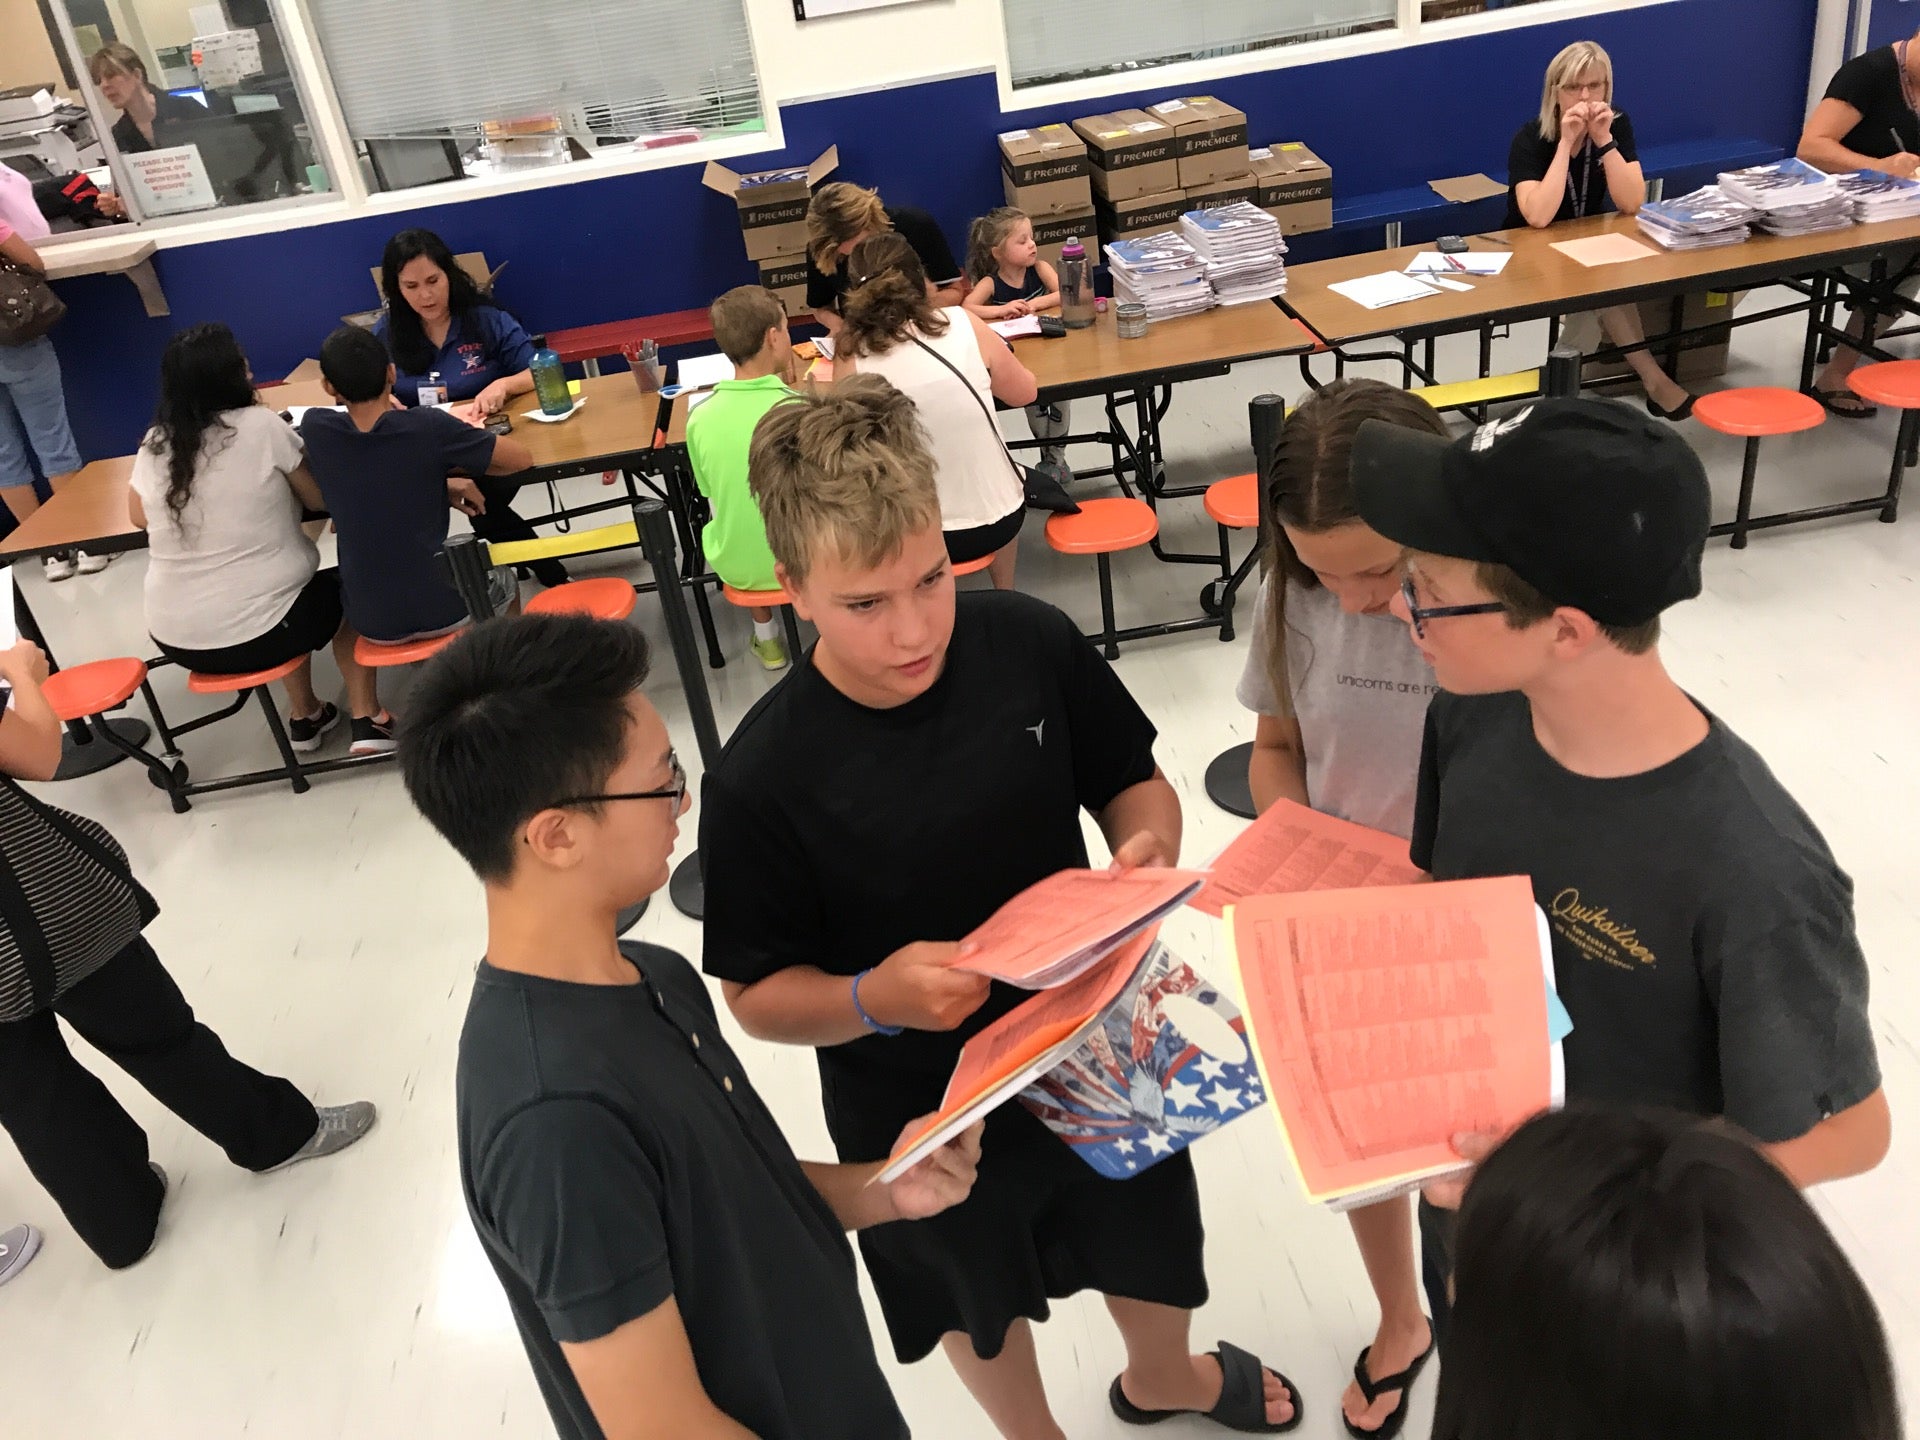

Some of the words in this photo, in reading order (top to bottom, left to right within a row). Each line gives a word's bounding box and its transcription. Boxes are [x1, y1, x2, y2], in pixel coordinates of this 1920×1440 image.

[1194, 133, 1239, 149] PREMIER
[1122, 147, 1166, 162] PREMIER
[1033, 164, 1079, 179] PREMIER
[1278, 187, 1322, 200] PREMIER
[758, 207, 802, 221] PREMIER
[1135, 209, 1178, 224] PREMIER
[1043, 225, 1086, 239] PREMIER
[780, 271, 808, 283] PREM
[1336, 674, 1394, 691] unicorns
[1397, 682, 1420, 694] are
[1424, 684, 1441, 695] re
[1551, 888, 1656, 964] Quiksilver
